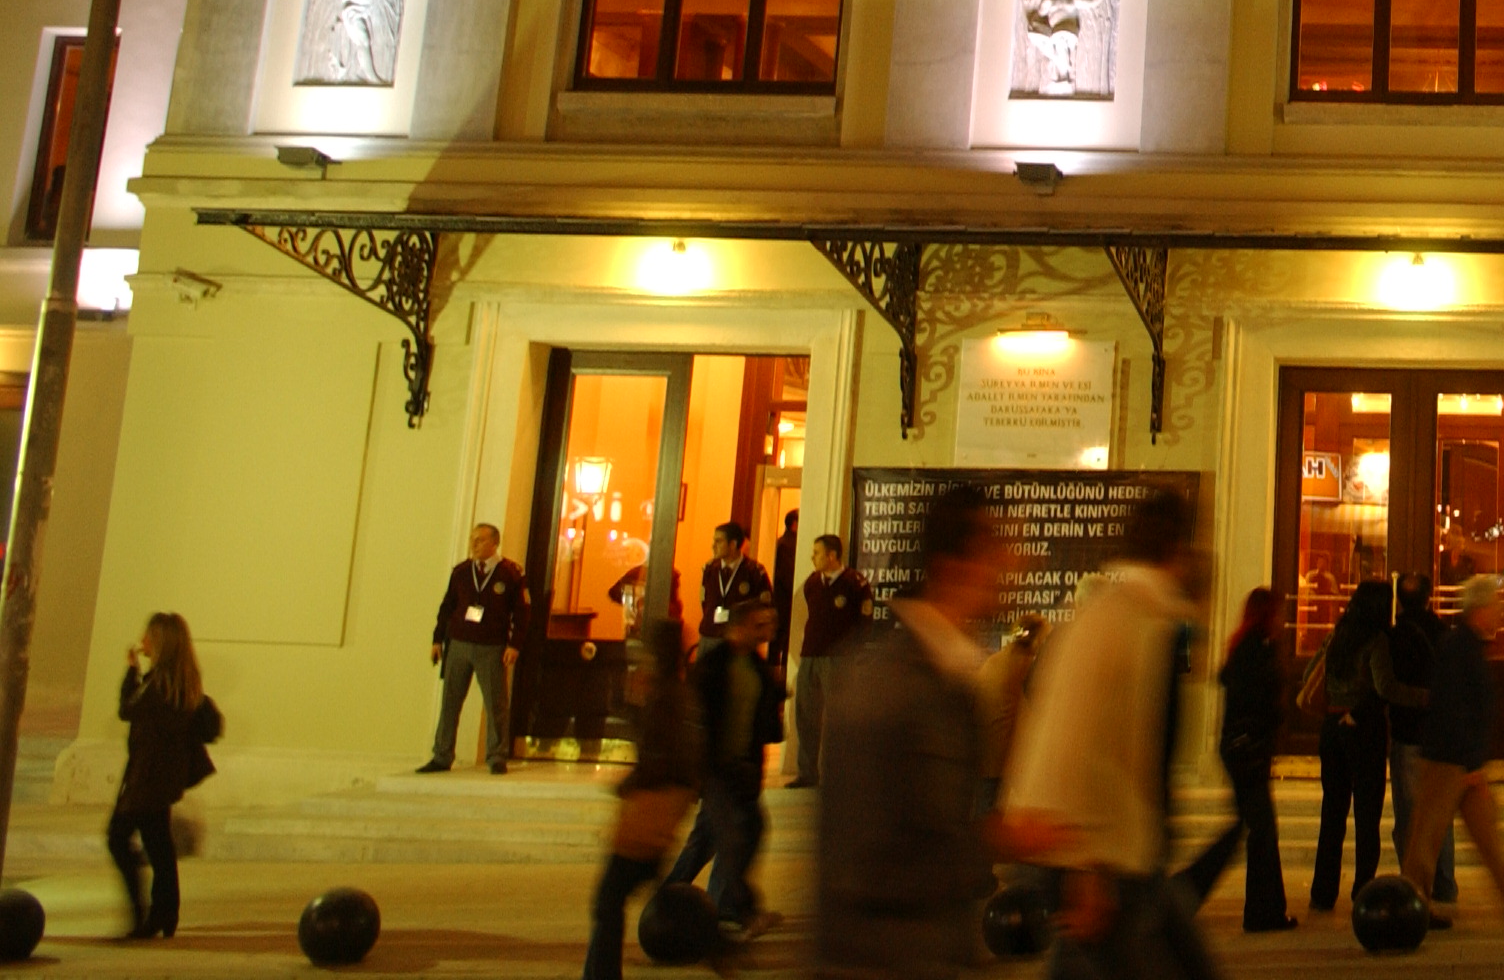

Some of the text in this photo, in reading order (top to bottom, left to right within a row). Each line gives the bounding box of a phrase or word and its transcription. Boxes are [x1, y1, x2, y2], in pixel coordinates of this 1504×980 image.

[865, 480, 935, 497] ÜLKEMİZİN
[984, 485, 1000, 500] VE
[1004, 481, 1105, 500] BÜTÜNLÜĞÜNÜ
[864, 498, 905, 516] TERÖR
[1008, 503, 1071, 518] NEFRETLE
[1022, 522, 1039, 537] EN
[1044, 520, 1084, 538] DERİN
[1088, 522, 1104, 537] VE
[1108, 522, 1124, 536] EN
[878, 565, 910, 582] EKİM
[996, 571, 1061, 586] APILACAK
